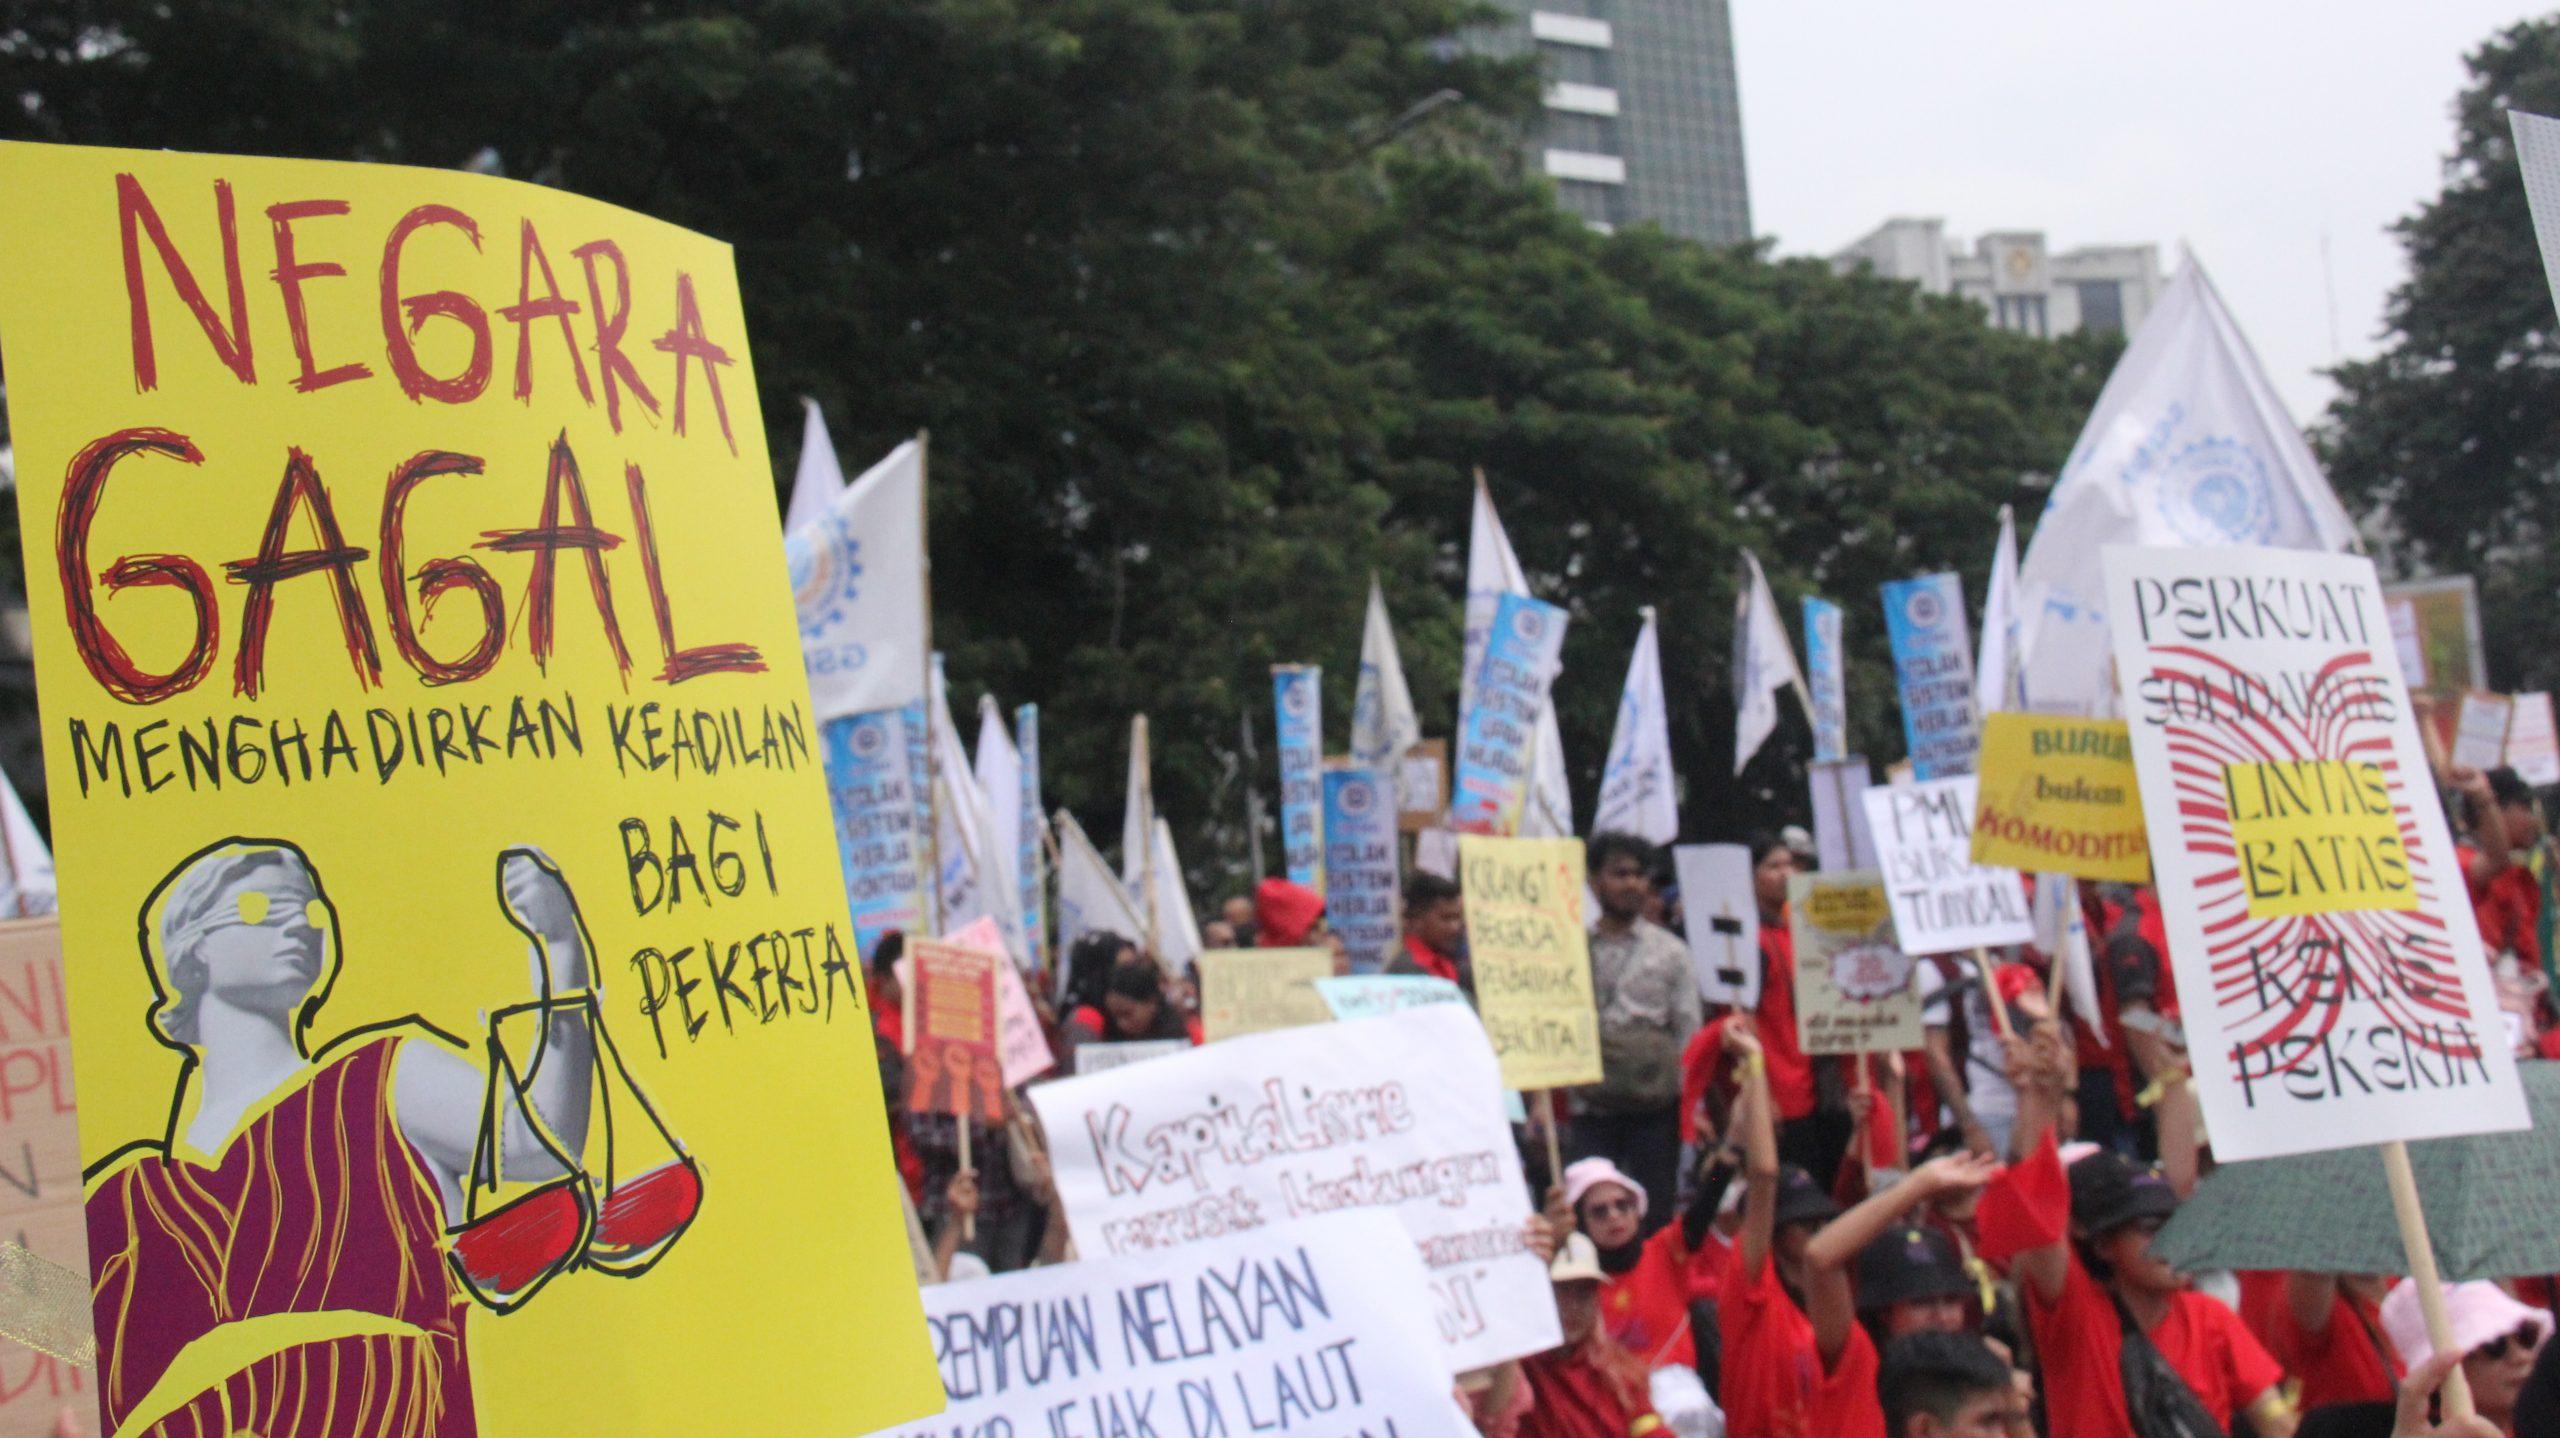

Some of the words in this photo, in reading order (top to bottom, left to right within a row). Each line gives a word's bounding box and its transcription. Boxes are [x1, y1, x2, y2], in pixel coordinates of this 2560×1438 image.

[114, 171, 738, 458] NEGARA
[56, 427, 769, 705] GAGAL
[2132, 576, 2368, 645] PERKUAT
[70, 691, 584, 800] MENGHADIRKAN
[606, 700, 809, 782] KEADILAN
[2223, 760, 2394, 822] LINTAS
[618, 807, 778, 917] BAGI
[2242, 835, 2408, 900] BATAS
[630, 921, 860, 1060] PEKERJA
[2234, 1020, 2490, 1109] PEKERJA
[1116, 1246, 1331, 1367] NELAYAN
[1233, 1337, 1363, 1432] LAUT
